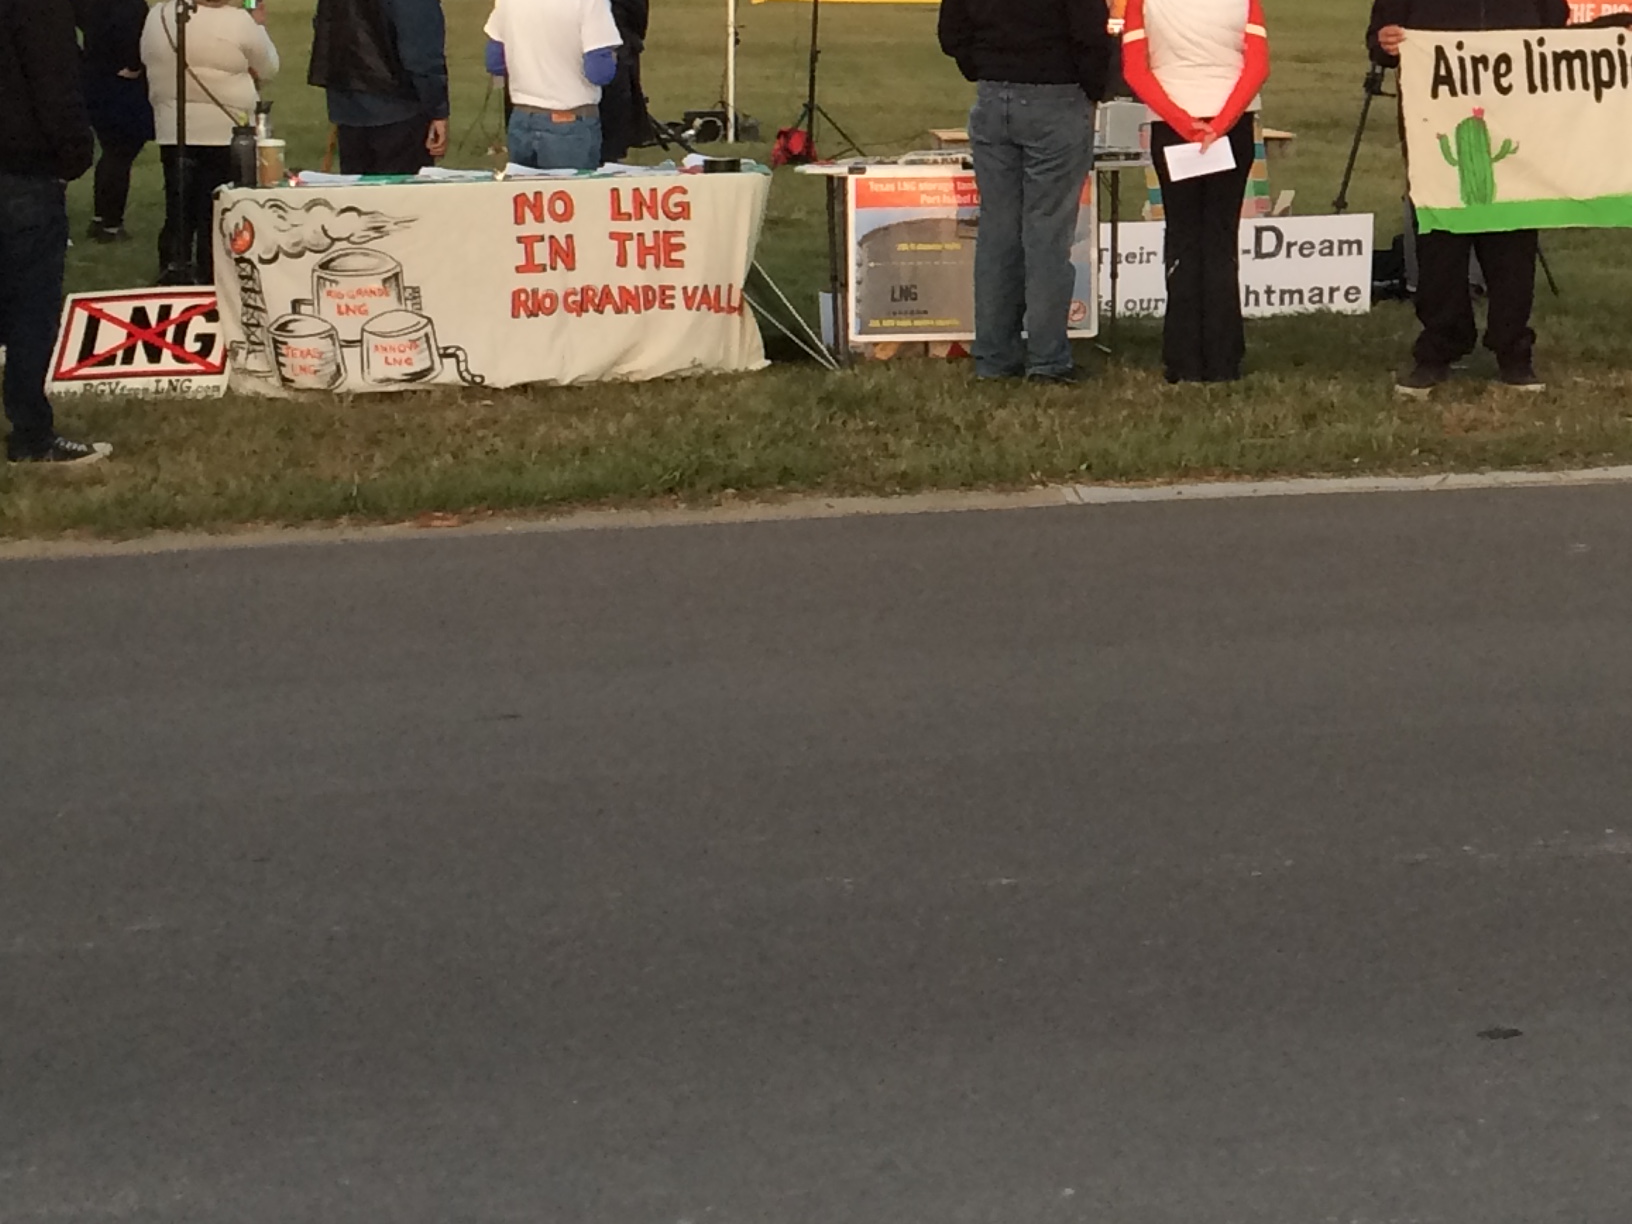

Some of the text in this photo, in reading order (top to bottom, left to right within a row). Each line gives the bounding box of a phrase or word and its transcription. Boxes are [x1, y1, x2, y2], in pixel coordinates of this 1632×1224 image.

[1431, 40, 1513, 99] Aire
[897, 180, 916, 192] LNG
[513, 186, 691, 225] NO LNG
[515, 230, 687, 274] IN THE
[326, 287, 391, 300] RIO GRANDE
[511, 287, 559, 319] RIO
[562, 284, 676, 317] GRANDE
[890, 284, 918, 303] LNG
[336, 304, 369, 316] LNG
[1124, 298, 1165, 312] our
[77, 304, 220, 367] LNG
[283, 345, 324, 361] TEXAS
[291, 364, 318, 376] LNG
[384, 357, 413, 367] LNG
